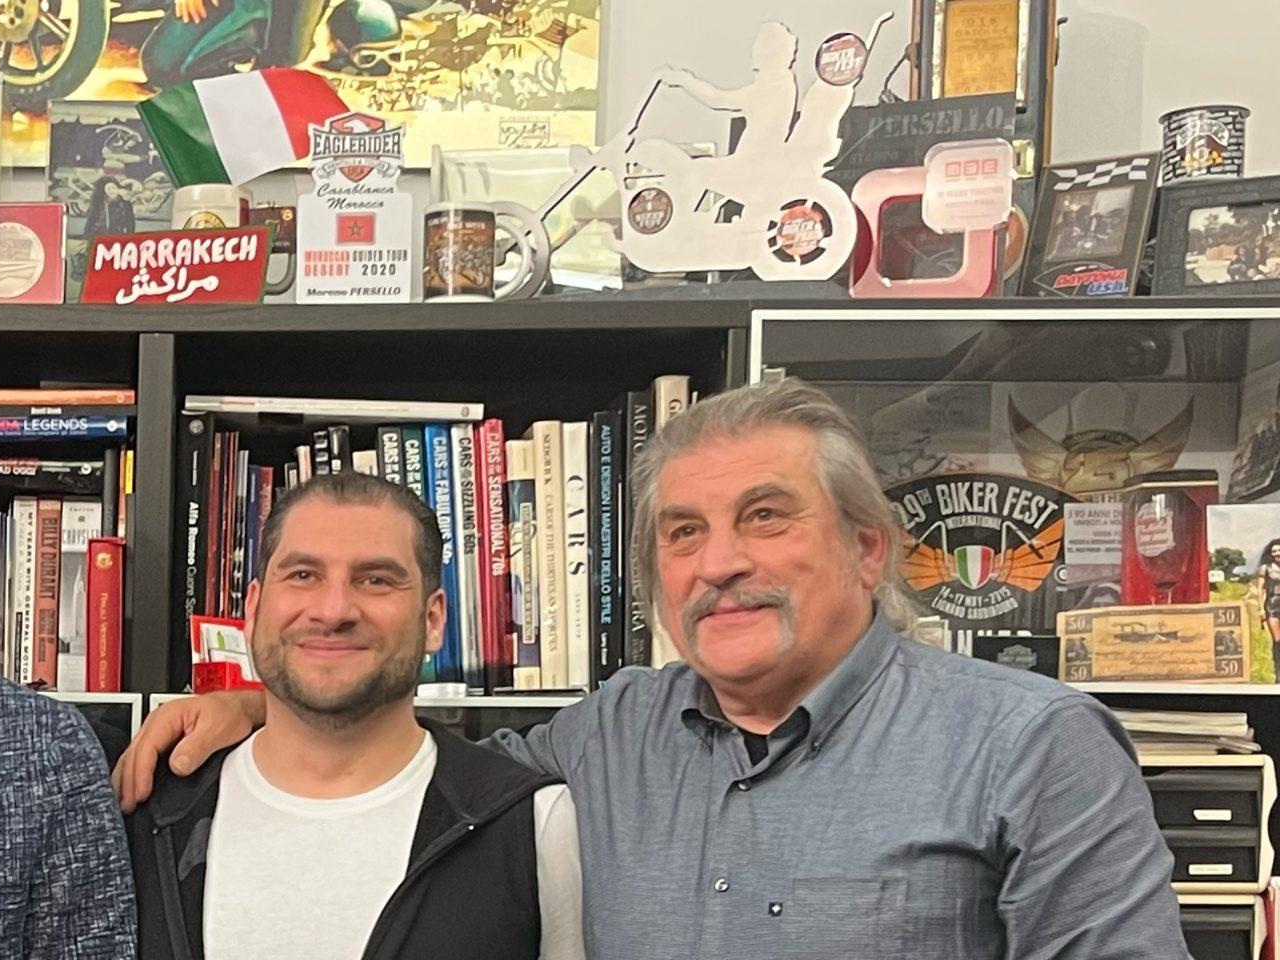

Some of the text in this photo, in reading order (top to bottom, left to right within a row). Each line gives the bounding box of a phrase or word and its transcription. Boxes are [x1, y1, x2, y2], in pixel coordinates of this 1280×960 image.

[312, 131, 401, 157] EAGLERIDER
[317, 183, 394, 197] Casablanca
[327, 197, 384, 209] Morocco
[94, 234, 258, 271] MARRAKECH
[361, 263, 396, 276] 2020
[1053, 269, 1127, 288] DAYTONA
[115, 266, 220, 305] مراكش
[23, 418, 88, 431] LEGENDS
[601, 425, 611, 454] AUTO
[383, 433, 398, 463] CARS
[405, 439, 421, 471] CARS
[433, 437, 448, 468] CARS
[459, 437, 472, 468] CARS
[487, 433, 502, 463] CARS
[601, 466, 611, 504] DESIGN
[27, 512, 33, 526] MY
[188, 502, 199, 525] Alfa
[461, 480, 475, 530] SIZZLING
[489, 476, 504, 555] SENSATIONAL
[935, 481, 1000, 516] BIKER
[1002, 486, 1059, 530] FEST
[567, 475, 586, 575] CARS
[601, 512, 611, 557] MAESTRI
[39, 517, 58, 600] BILLY DURANT
[188, 527, 198, 565] Romeo
[187, 566, 197, 597] Cuore
[601, 560, 611, 593] DELLO
[601, 595, 611, 624] STILE
[631, 601, 645, 632] ERA
[1069, 607, 1237, 630] 50 50
[1070, 660, 1239, 681] 50 50
